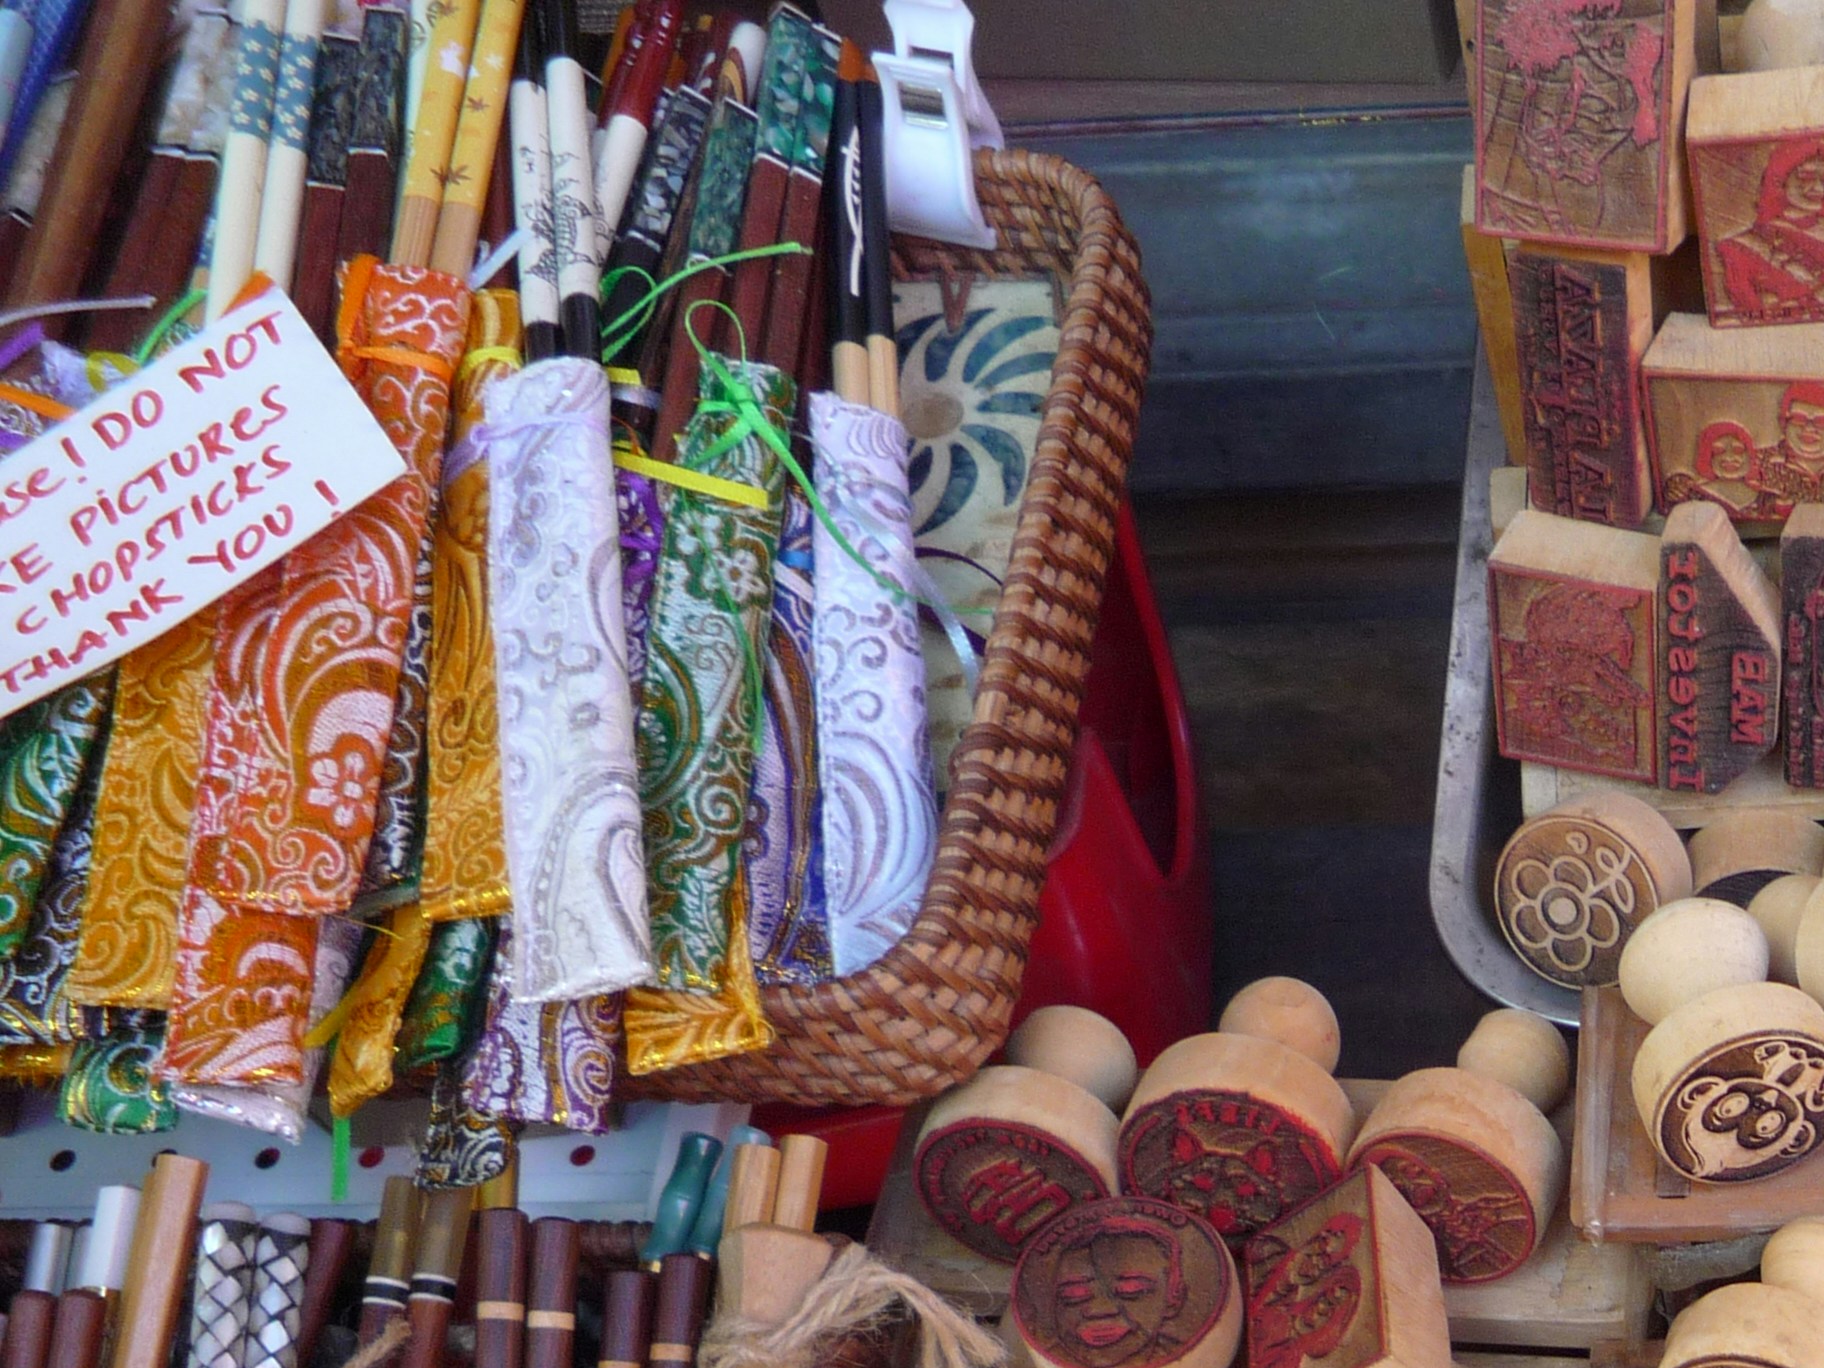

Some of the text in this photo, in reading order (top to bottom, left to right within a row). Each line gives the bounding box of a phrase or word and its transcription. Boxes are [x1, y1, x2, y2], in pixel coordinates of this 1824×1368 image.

[92, 390, 163, 450] DO
[179, 311, 284, 393] NOT
[0, 578, 184, 693] THANK
[187, 504, 293, 573] YOU
[16, 445, 292, 635] CHOPSTICKS
